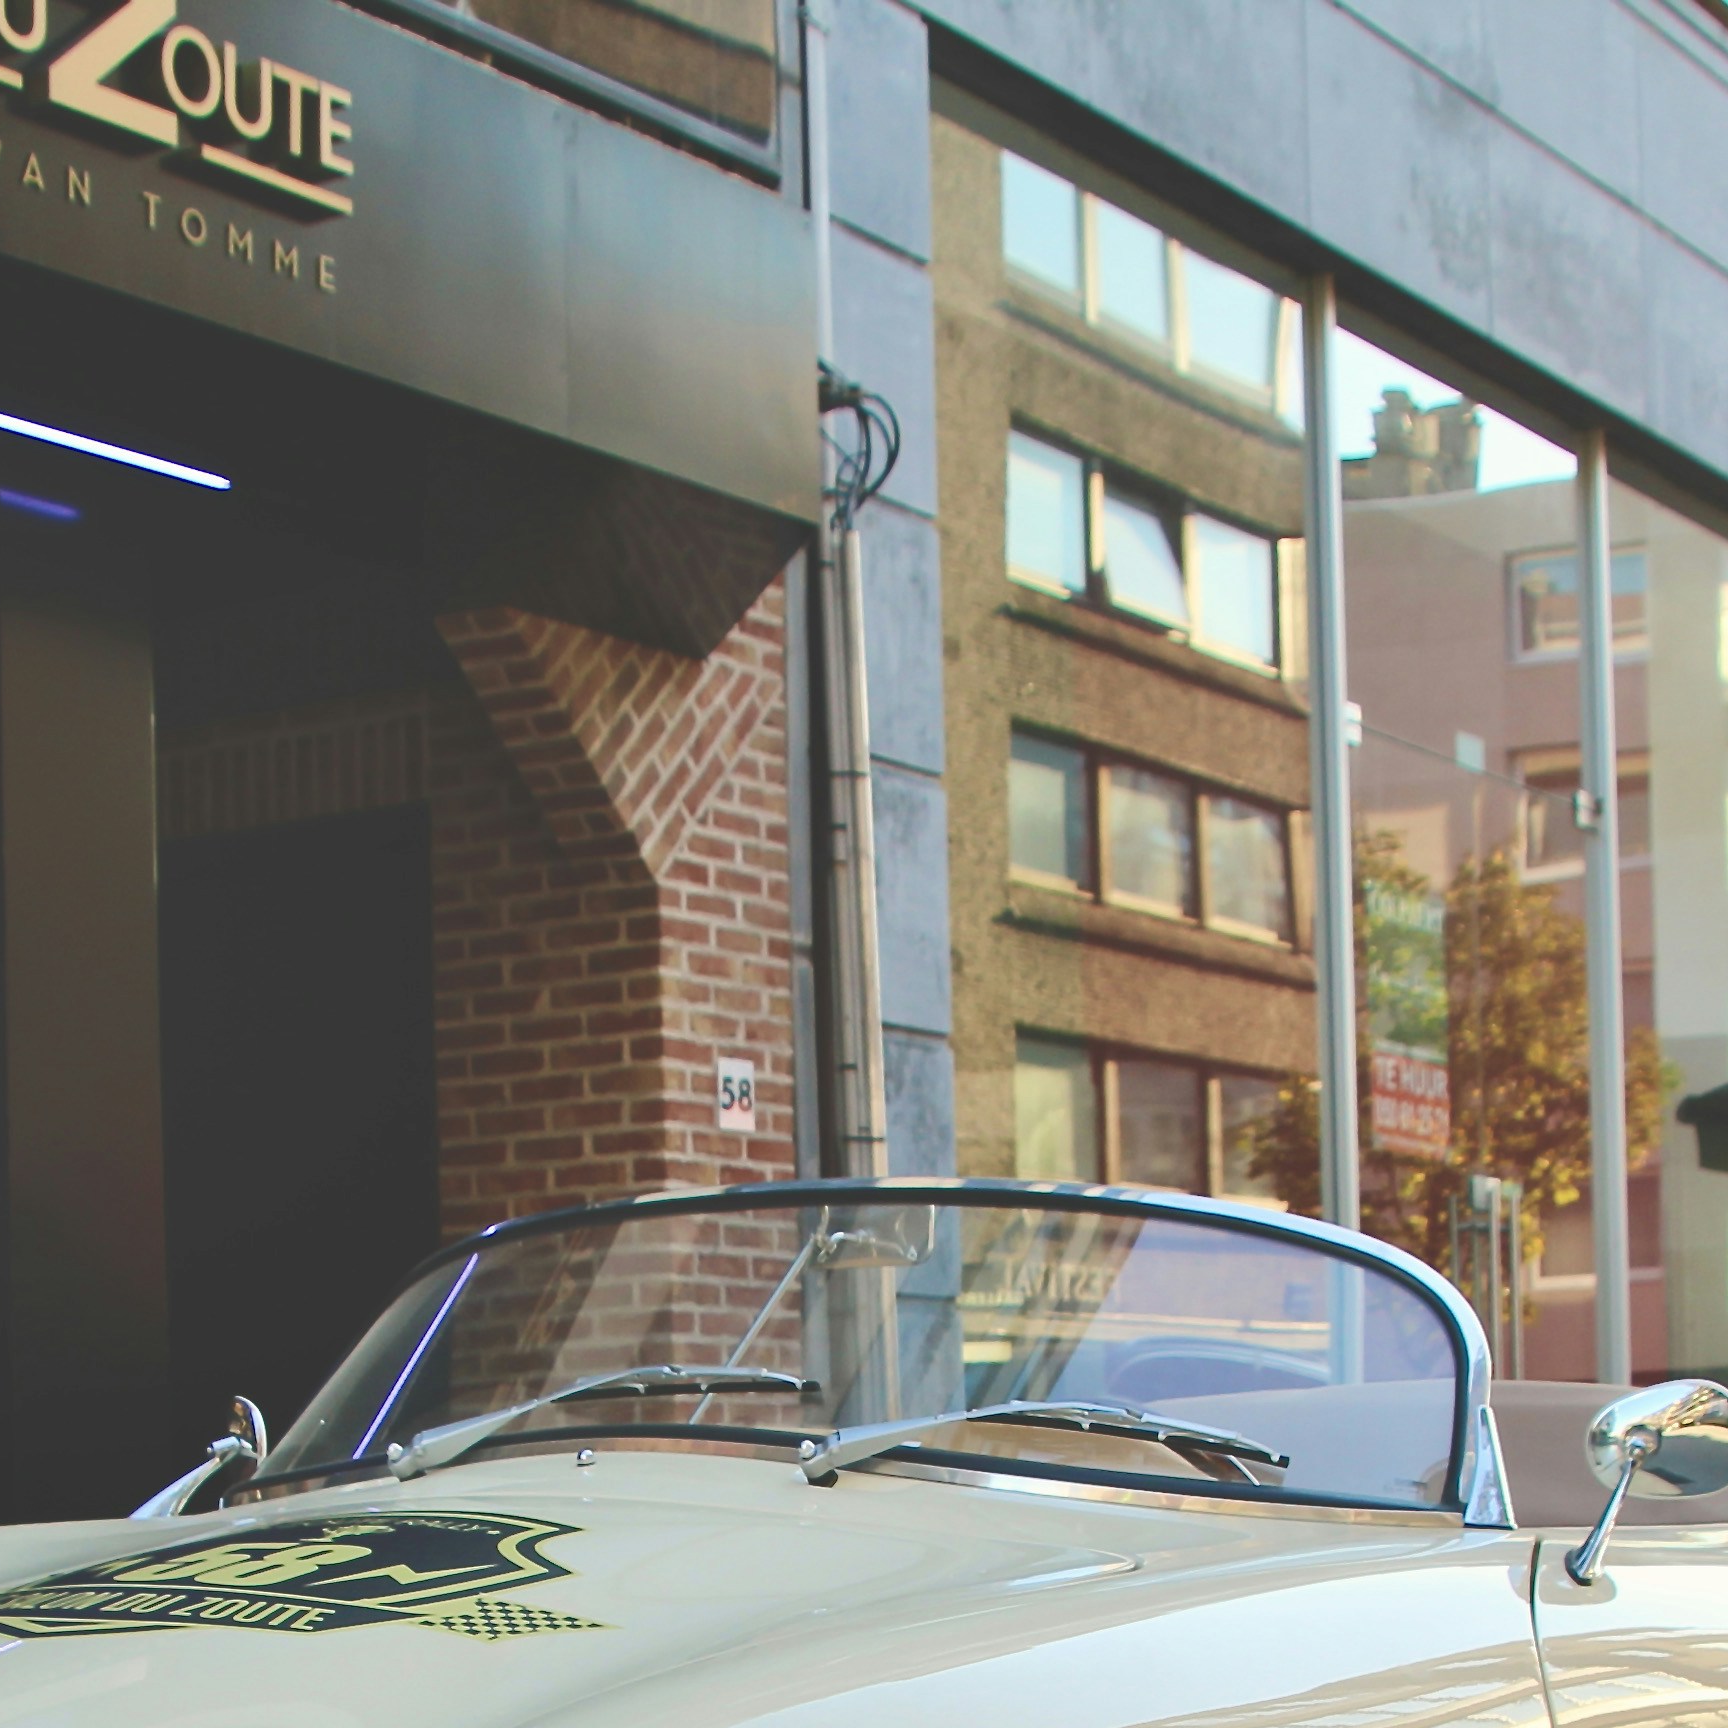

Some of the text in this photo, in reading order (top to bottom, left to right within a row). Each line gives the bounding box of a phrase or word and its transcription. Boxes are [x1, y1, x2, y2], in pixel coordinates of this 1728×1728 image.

[48, 0, 355, 176] ZOUTE
[142, 190, 339, 293] TOMME
[721, 1075, 753, 1111] 58
[113, 1542, 372, 1586] 58
[99, 1592, 187, 1614] DU
[168, 1596, 336, 1631] ZOUTE
